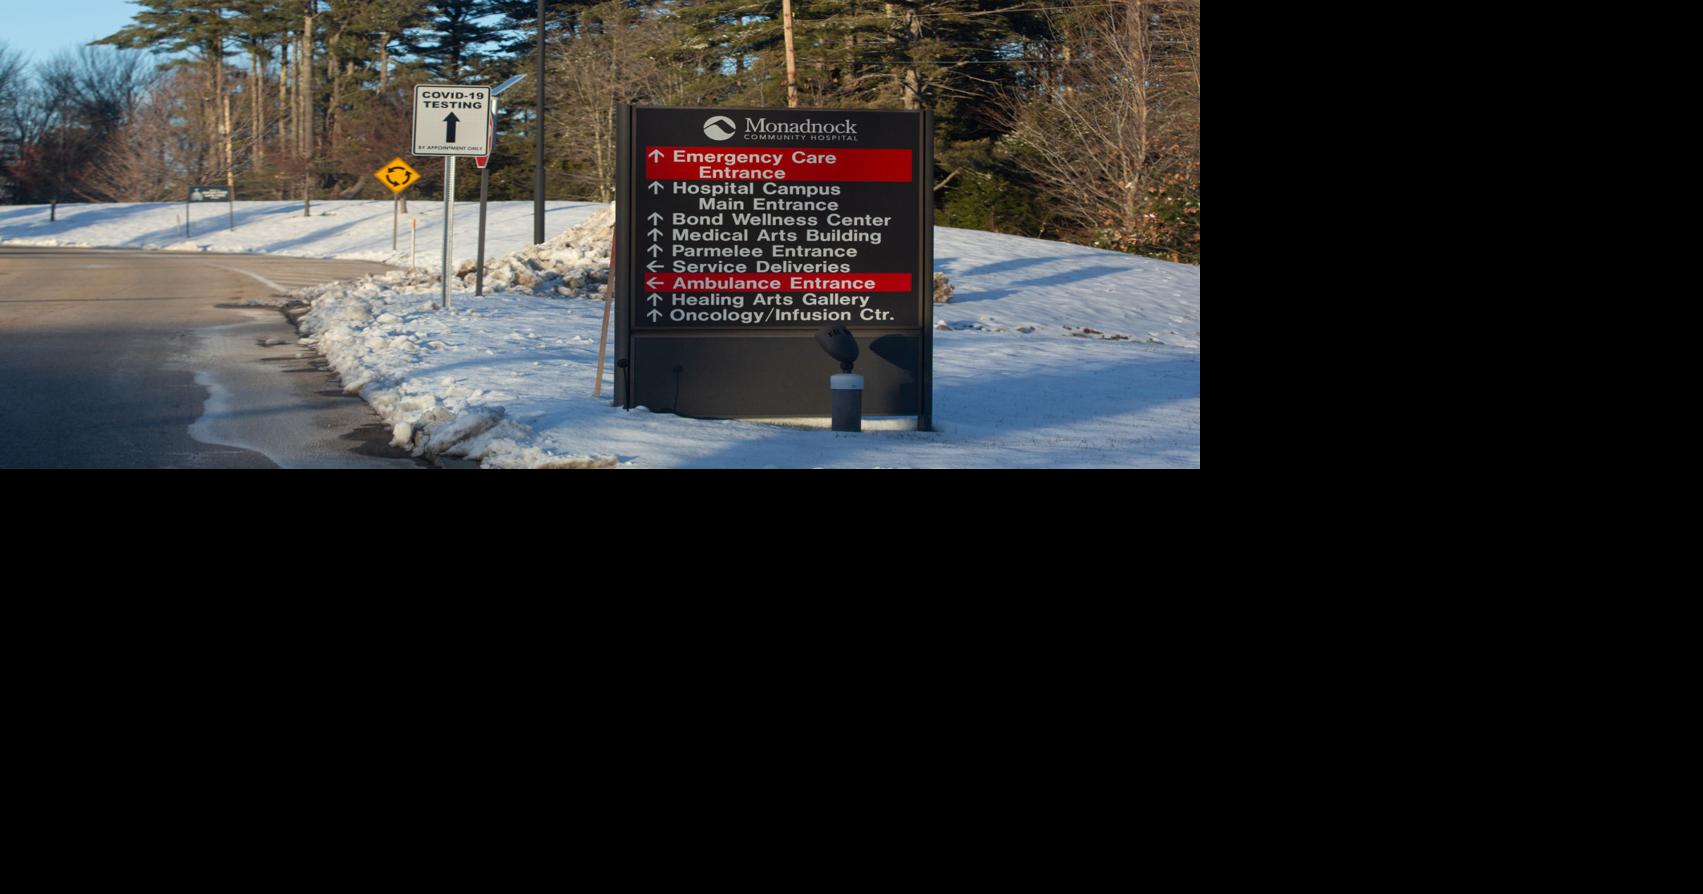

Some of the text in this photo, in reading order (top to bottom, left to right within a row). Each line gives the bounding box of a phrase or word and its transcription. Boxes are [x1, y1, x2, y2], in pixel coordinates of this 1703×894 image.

[422, 91, 484, 99] COVID-19
[423, 101, 482, 109] TESTING
[744, 117, 858, 133] Monadnock
[673, 150, 837, 166] Emergency Care
[699, 166, 786, 180] Entrance
[673, 181, 841, 198] Hospital Campus
[699, 198, 839, 211] Main Entrance
[672, 213, 892, 227] Bond Wellness Center
[672, 228, 882, 245] Medical Arts Building
[672, 245, 858, 258] Parmelee Entrance
[672, 260, 851, 274] Service Deliveries
[672, 276, 876, 290] Ambulance Entrance
[672, 293, 870, 309] Healing Arts Gallery
[669, 307, 895, 324] Oncology/Infusion Ctr.
